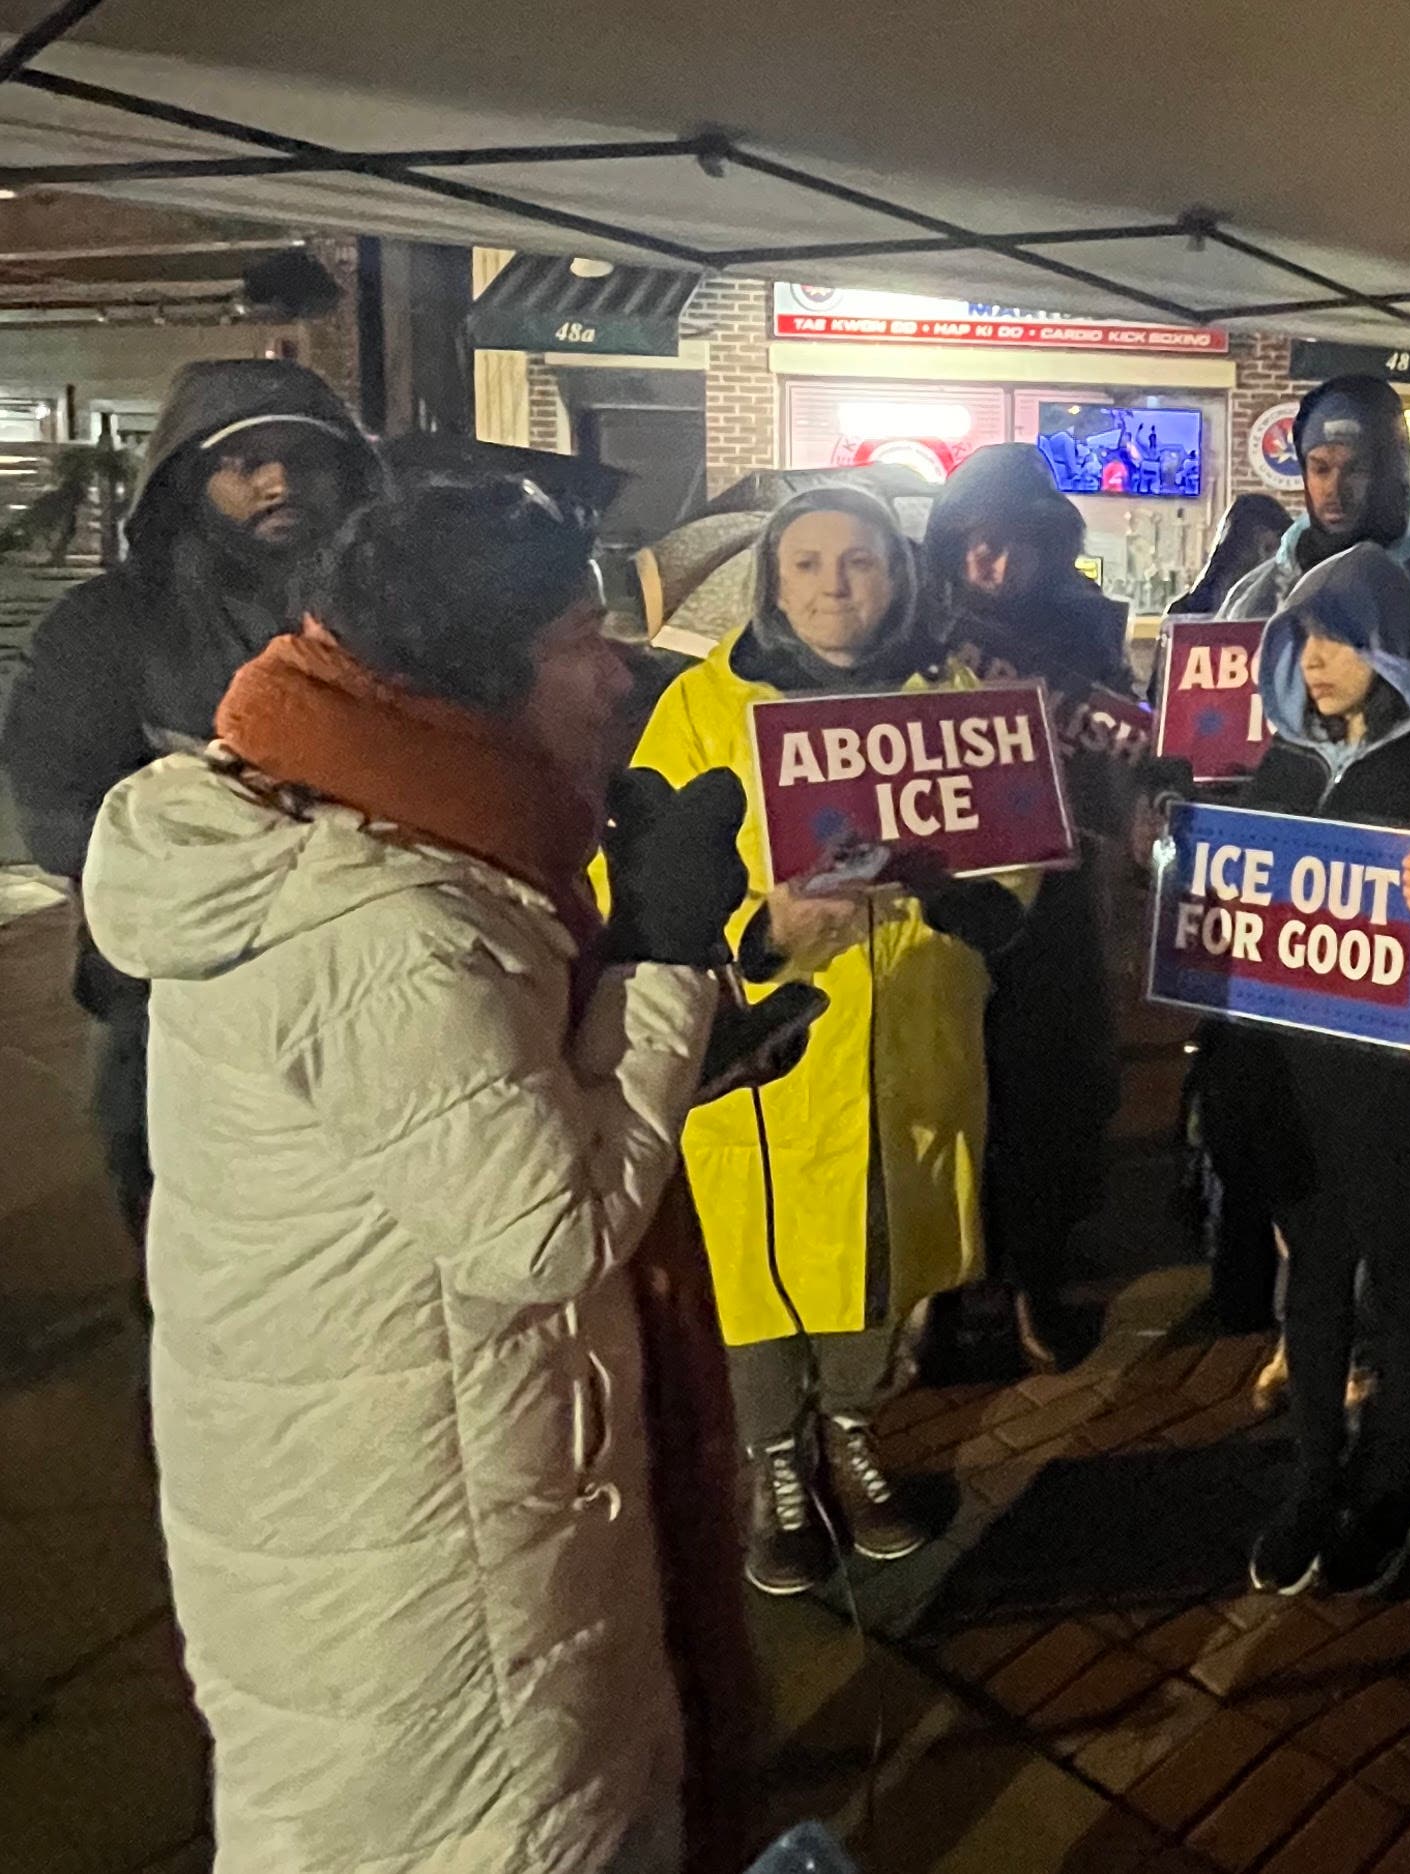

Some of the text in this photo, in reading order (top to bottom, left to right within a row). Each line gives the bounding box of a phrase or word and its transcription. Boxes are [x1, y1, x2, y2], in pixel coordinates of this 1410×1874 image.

[555, 321, 595, 343] 48a
[794, 317, 826, 331] TAE
[831, 318, 885, 333] KWON
[933, 322, 970, 336] HAP
[975, 324, 993, 337] KI
[1040, 327, 1103, 342] CARDIO
[1108, 329, 1146, 344] KICK
[1149, 331, 1211, 347] BOXING
[1385, 351, 1410, 371] 48
[1179, 645, 1261, 691] AB
[778, 714, 1036, 787] ABOLISH
[875, 774, 980, 841] ICE
[1190, 841, 1402, 926] ICE OUT
[1174, 901, 1405, 987] FOR GOOD
